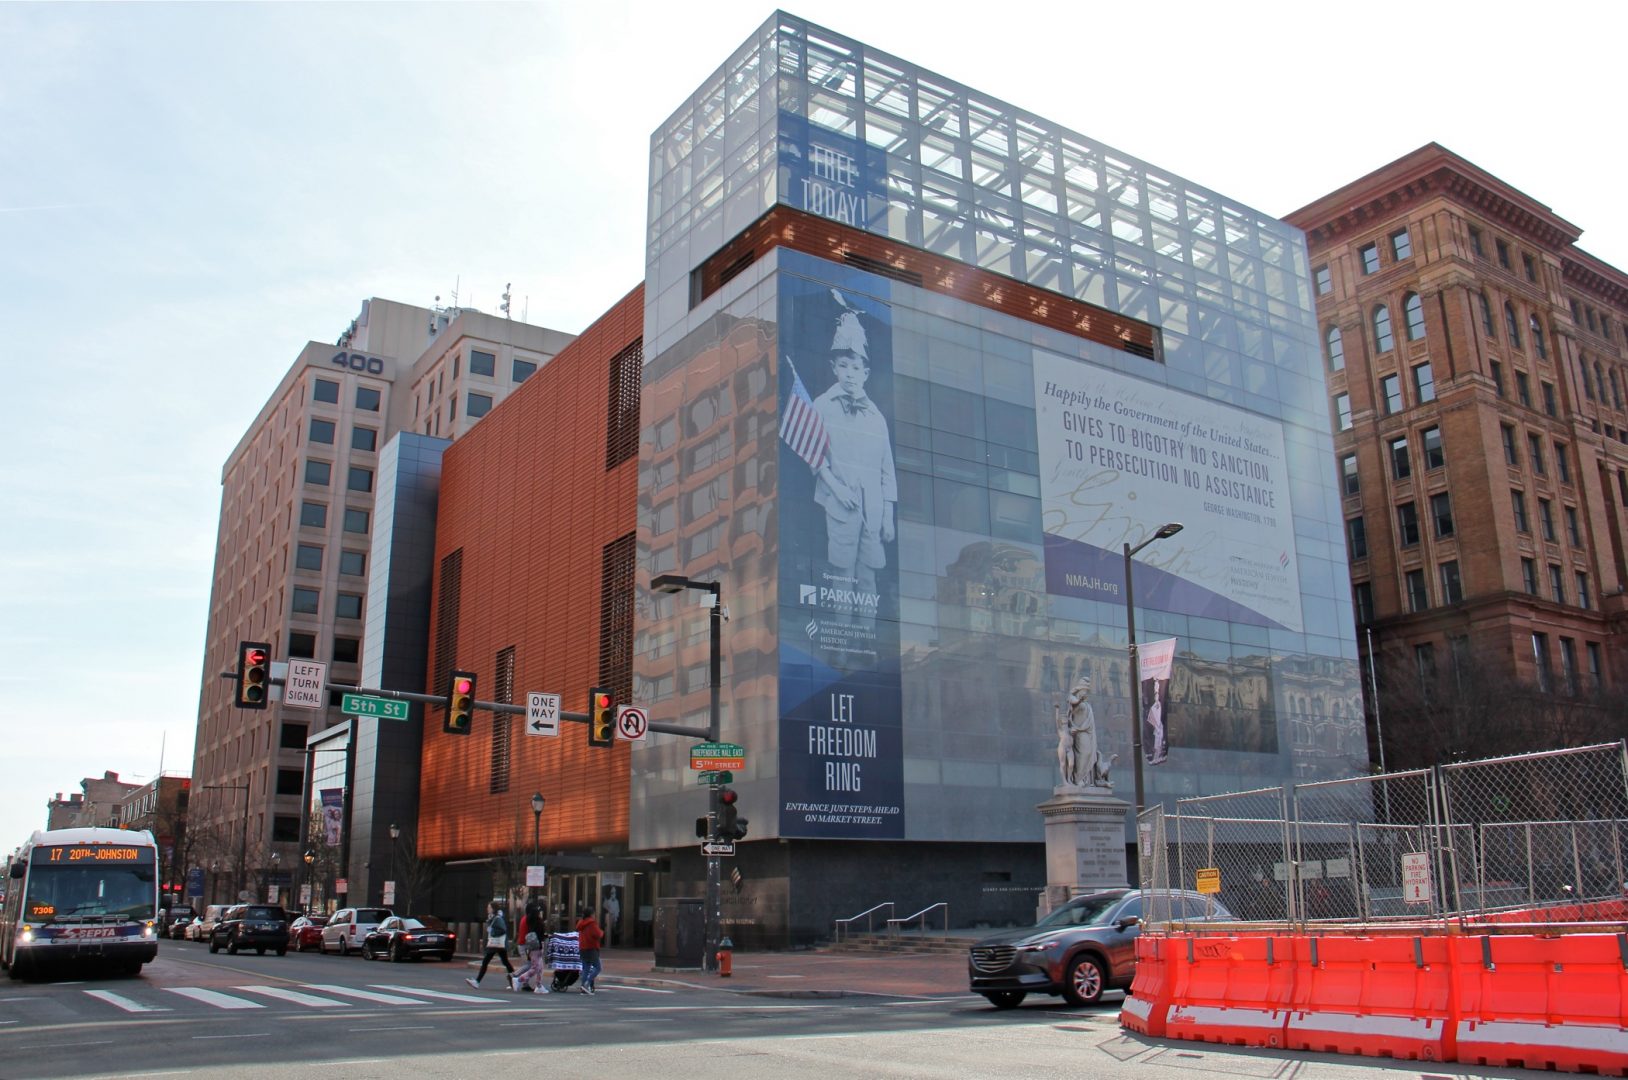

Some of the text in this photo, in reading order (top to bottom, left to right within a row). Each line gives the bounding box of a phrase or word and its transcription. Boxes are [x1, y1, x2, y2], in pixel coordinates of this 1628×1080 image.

[812, 144, 856, 188] FREE
[801, 178, 866, 230] TODAY!
[332, 351, 384, 375] 400
[1044, 381, 1091, 410] Happily
[1093, 396, 1111, 411] the
[1114, 400, 1178, 431] Government
[1181, 421, 1192, 438] of
[1192, 423, 1207, 438] the
[1210, 428, 1242, 449] United
[1063, 410, 1104, 439] GIVES
[1109, 422, 1126, 444] TO
[1131, 428, 1184, 460] BIGOTRY
[1190, 444, 1207, 466] NO
[1065, 439, 1083, 461] TO
[1090, 445, 1178, 485] PERSECUTION
[1183, 468, 1200, 490] NO
[1205, 474, 1276, 509] ASSISTANCE
[1203, 501, 1225, 516] GEORGE
[822, 572, 852, 582] Sponsored
[1065, 573, 1118, 595] NMAJH.org
[820, 587, 880, 607] PARKWAY
[820, 601, 878, 614] Corporation
[820, 626, 854, 637] AMERICAN
[820, 636, 848, 646] HISTORY
[294, 665, 321, 677] LEFT
[292, 677, 320, 690] TURN
[288, 690, 320, 703] SIGNAL
[532, 696, 555, 707] ONE
[350, 699, 400, 716] 5th St
[531, 707, 555, 719] WAY
[831, 693, 854, 723] LET
[808, 725, 877, 758] FREEDOM
[695, 760, 713, 769] 5TH
[825, 761, 861, 792] RING
[785, 802, 900, 815] ENTRANCE JUST STEPS AHEAD
[804, 814, 883, 825] ON MARKET STREET.
[50, 848, 138, 861] 17 20TH-JOHNSTON
[1405, 877, 1428, 886] HYDRANT
[79, 928, 115, 938] SEPTA
